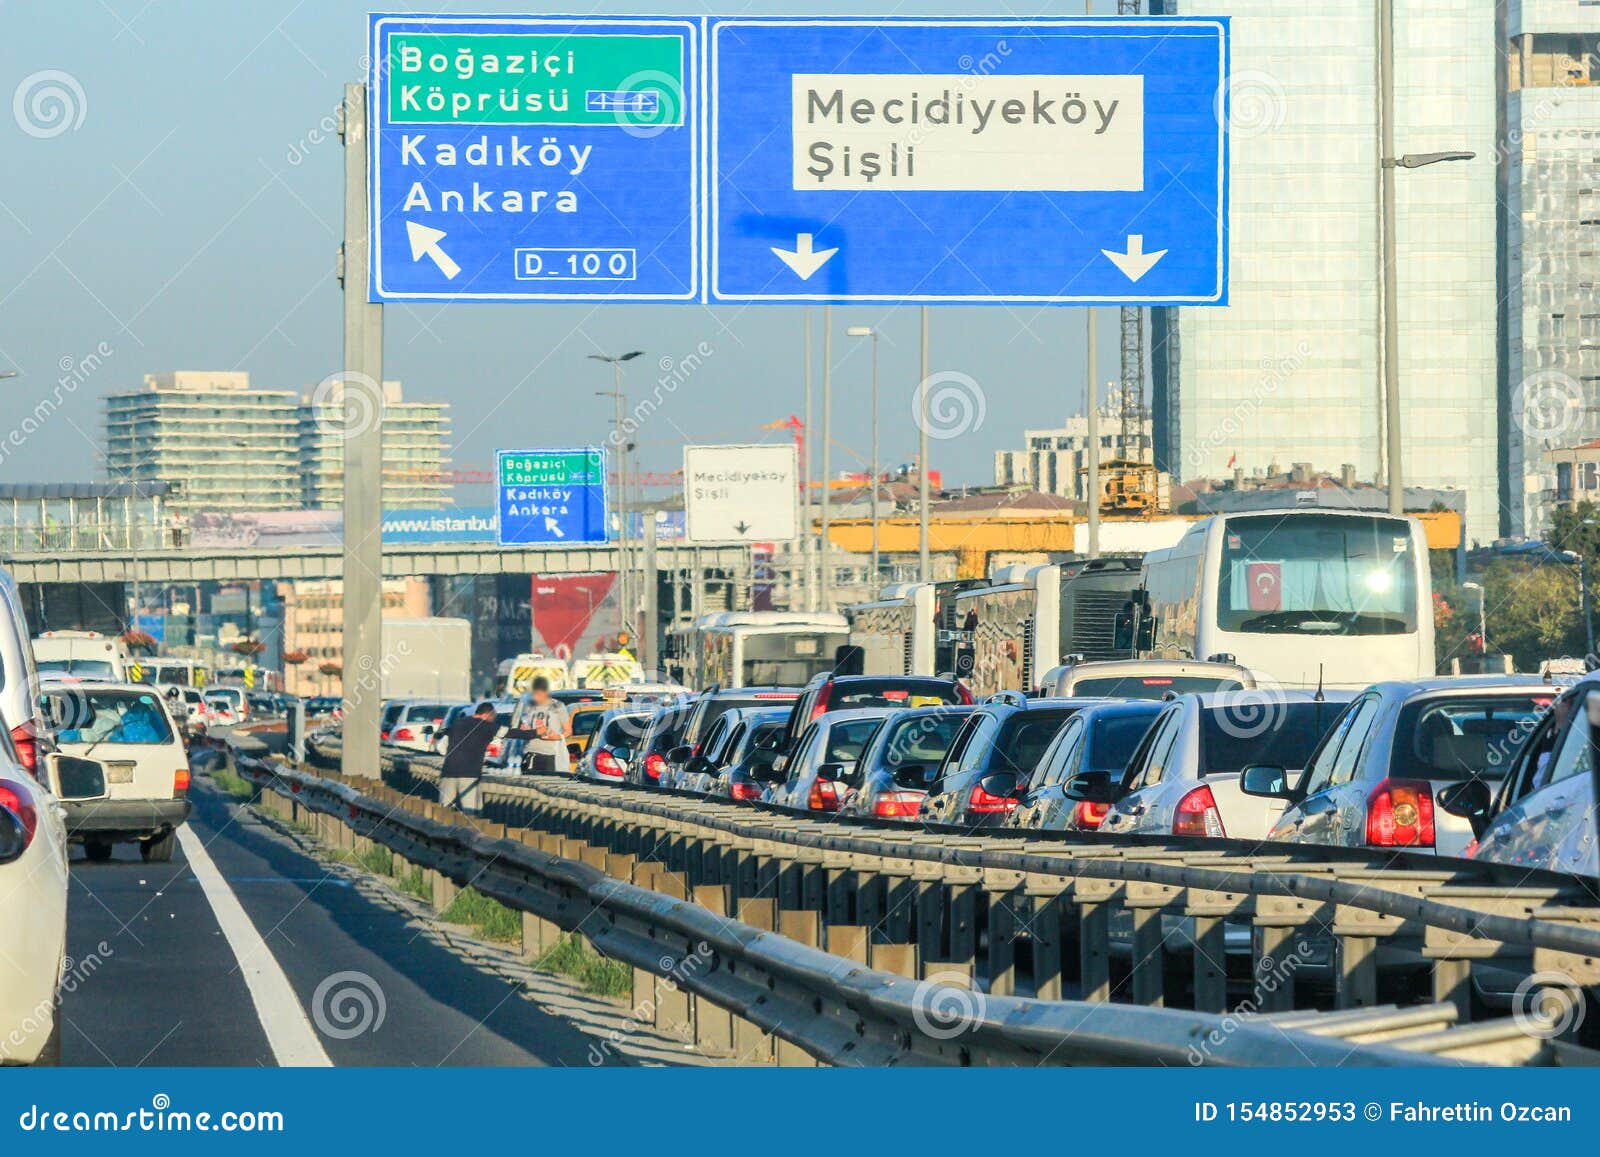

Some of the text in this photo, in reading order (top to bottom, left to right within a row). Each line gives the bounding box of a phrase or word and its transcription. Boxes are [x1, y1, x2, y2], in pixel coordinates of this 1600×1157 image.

[401, 46, 575, 80] Boğaziçi
[401, 85, 569, 118] Köprüsü
[806, 89, 1119, 134] Mecidiyeköy
[401, 134, 593, 176] Kadıköy
[806, 142, 915, 183] Şişli
[402, 182, 578, 213] Ankara
[508, 503, 569, 516] Ankara
